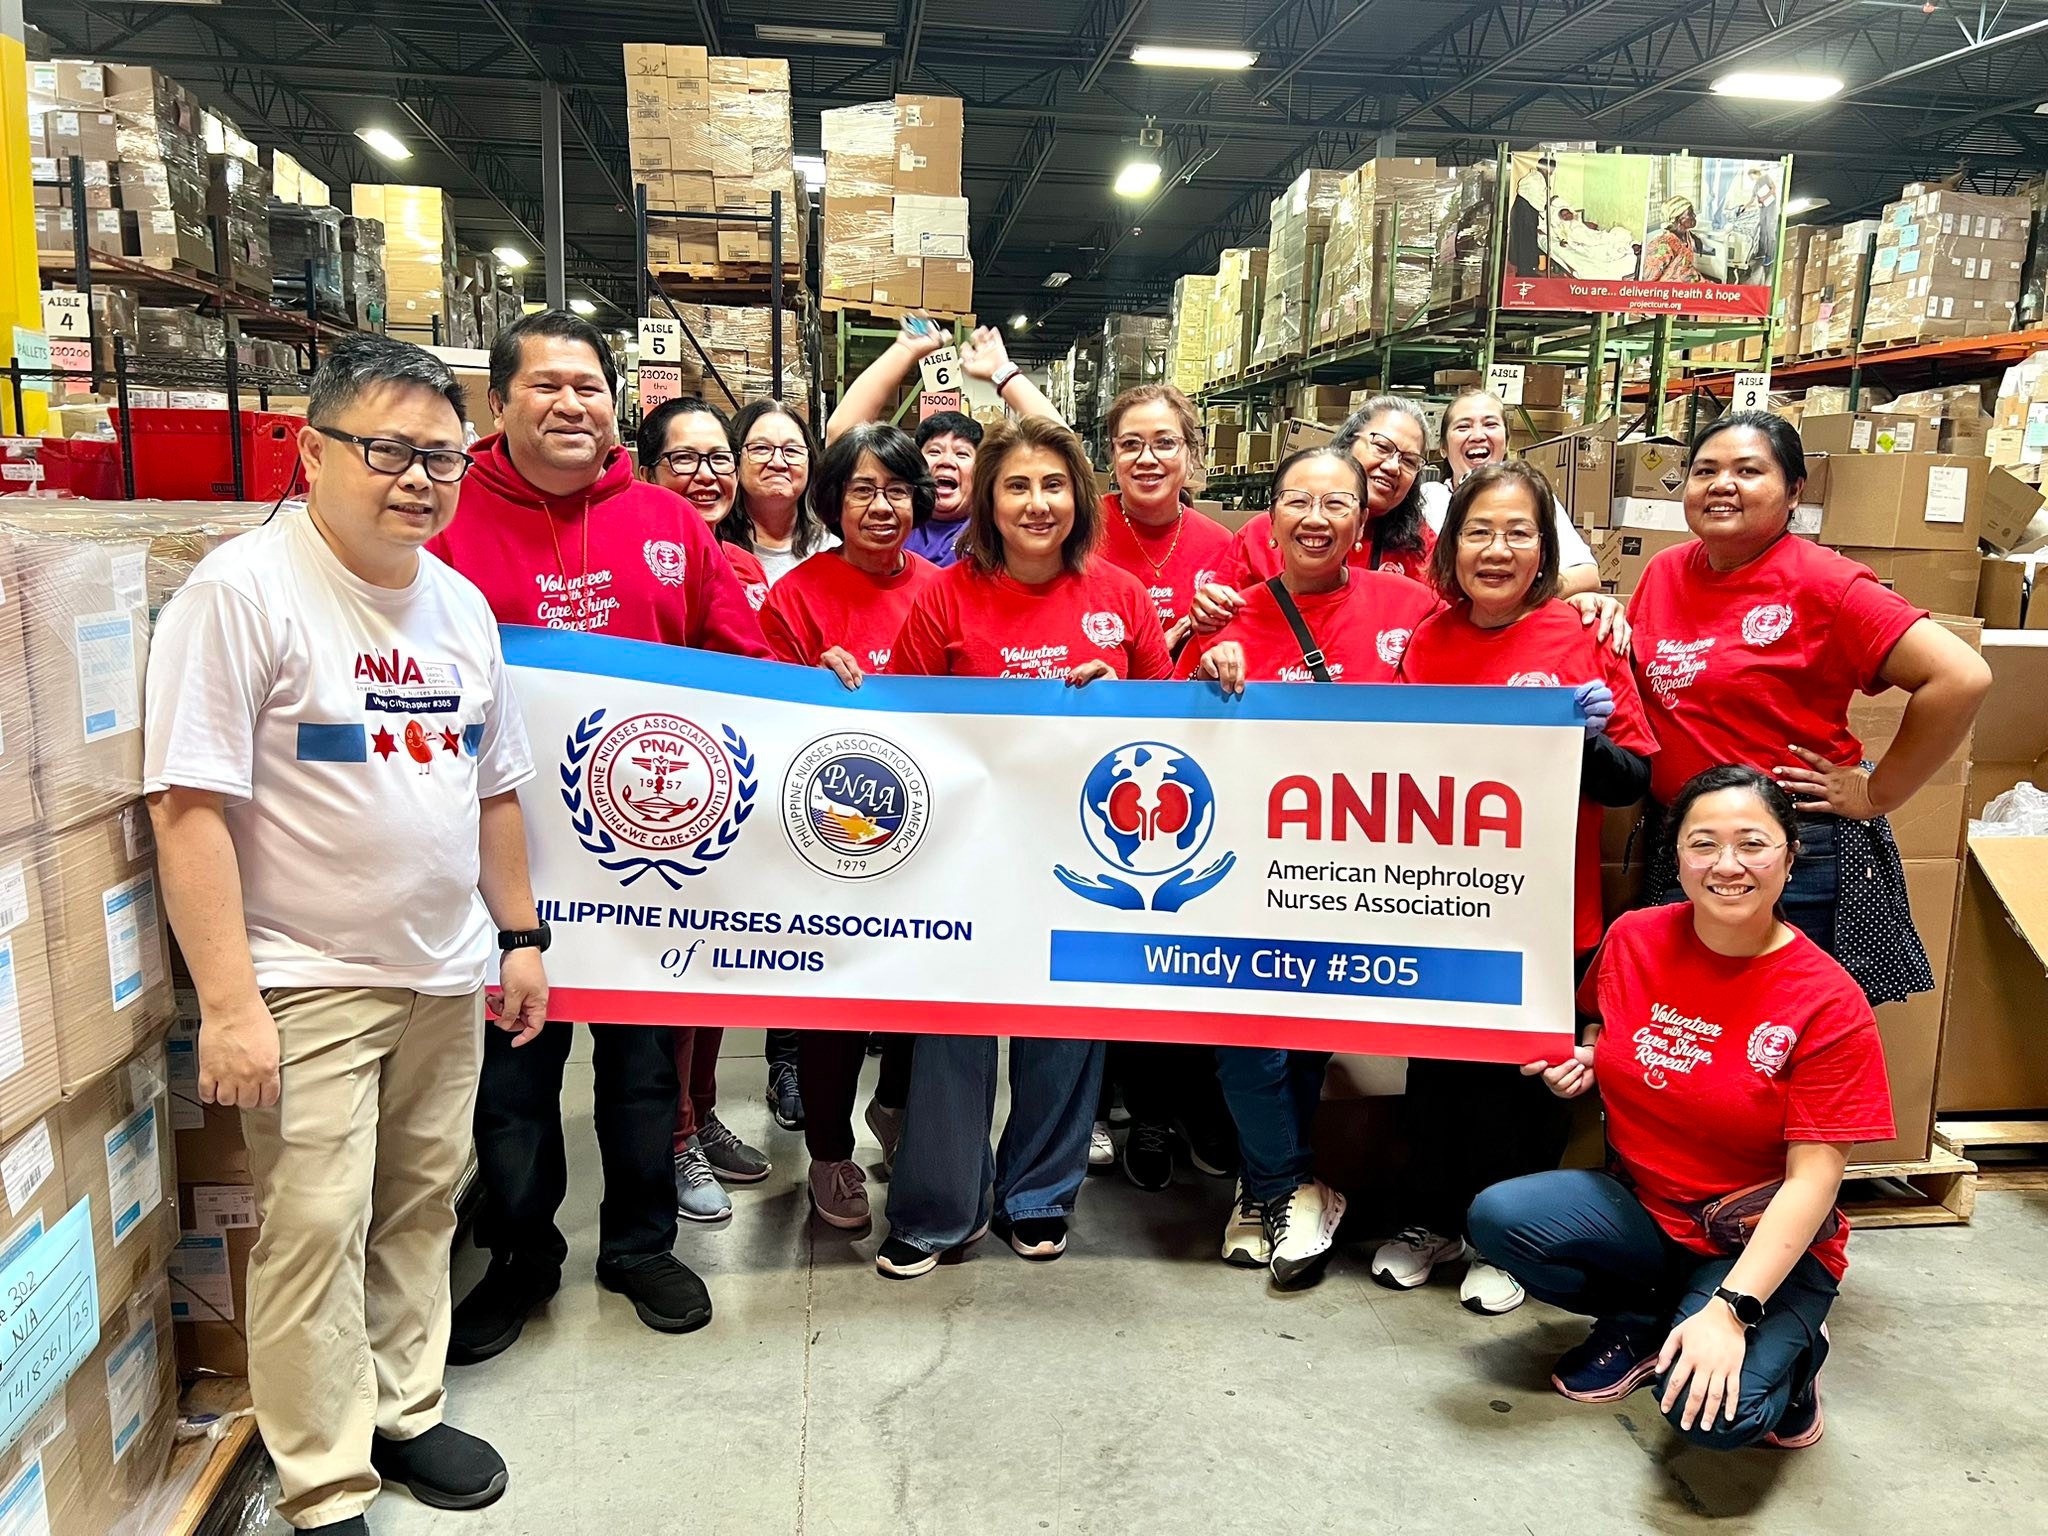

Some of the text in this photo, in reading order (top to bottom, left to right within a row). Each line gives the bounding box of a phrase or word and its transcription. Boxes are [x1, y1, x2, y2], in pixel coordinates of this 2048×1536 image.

[48, 297, 80, 307] AISLE
[1569, 284, 1741, 302] You are... delivering health & hope
[1629, 301, 1682, 310] projectcure.org
[60, 313, 73, 330] 4
[642, 324, 673, 334] AISLE
[17, 343, 48, 360] PALLETS
[50, 346, 90, 358] 230200
[653, 337, 665, 355] 5
[924, 352, 952, 366] AISLE
[640, 370, 679, 381] 230202
[936, 367, 949, 385] 6
[1490, 368, 1518, 378] AISLE
[1738, 377, 1764, 386] AISLE
[646, 394, 672, 405] 3312
[1498, 383, 1508, 398] 7
[1745, 390, 1756, 407] 8
[922, 395, 957, 406] 750001
[536, 570, 613, 592] Voluneer
[559, 590, 582, 602] wth
[576, 596, 621, 618] Shine,
[1000, 645, 1069, 663] Volunteer
[1656, 637, 1716, 654] Volunteer
[1021, 659, 1041, 669] with
[1036, 666, 1072, 679] Shine
[1278, 663, 1344, 682] Voluer
[1645, 659, 1707, 677] Care, Shine,
[1651, 671, 1697, 695] Repeat!
[639, 739, 684, 757] PNAI
[593, 718, 727, 838] PHILIPPINE NURSES ASSOCIATION OF ILLINOIS
[789, 738, 923, 854] PHILIPPINE NURSES ASSOCIATION OF AMERICA
[824, 764, 896, 814] PNAA
[1267, 772, 1522, 849] ANNA
[627, 827, 685, 846] WE CARE
[835, 858, 867, 872] 1979
[1267, 860, 1525, 895] American Nephrology
[1267, 889, 1491, 918] Nurses Association
[535, 899, 972, 941] HILIPPINE NURSES ASSOCIATION
[660, 938, 824, 978] of ILLINOIS
[1143, 944, 1419, 988] Windy City #305
[1650, 1002, 1723, 1038] Volunteer
[1662, 1025, 1698, 1042] with us
[1632, 1027, 1713, 1065] Care, Shine,
[1634, 1044, 1698, 1075] Repeat!
[7, 1270, 37, 1308] 302
[73, 1300, 89, 1332] 25
[12, 1307, 39, 1348] N/A
[8, 1334, 62, 1413] 1418561
